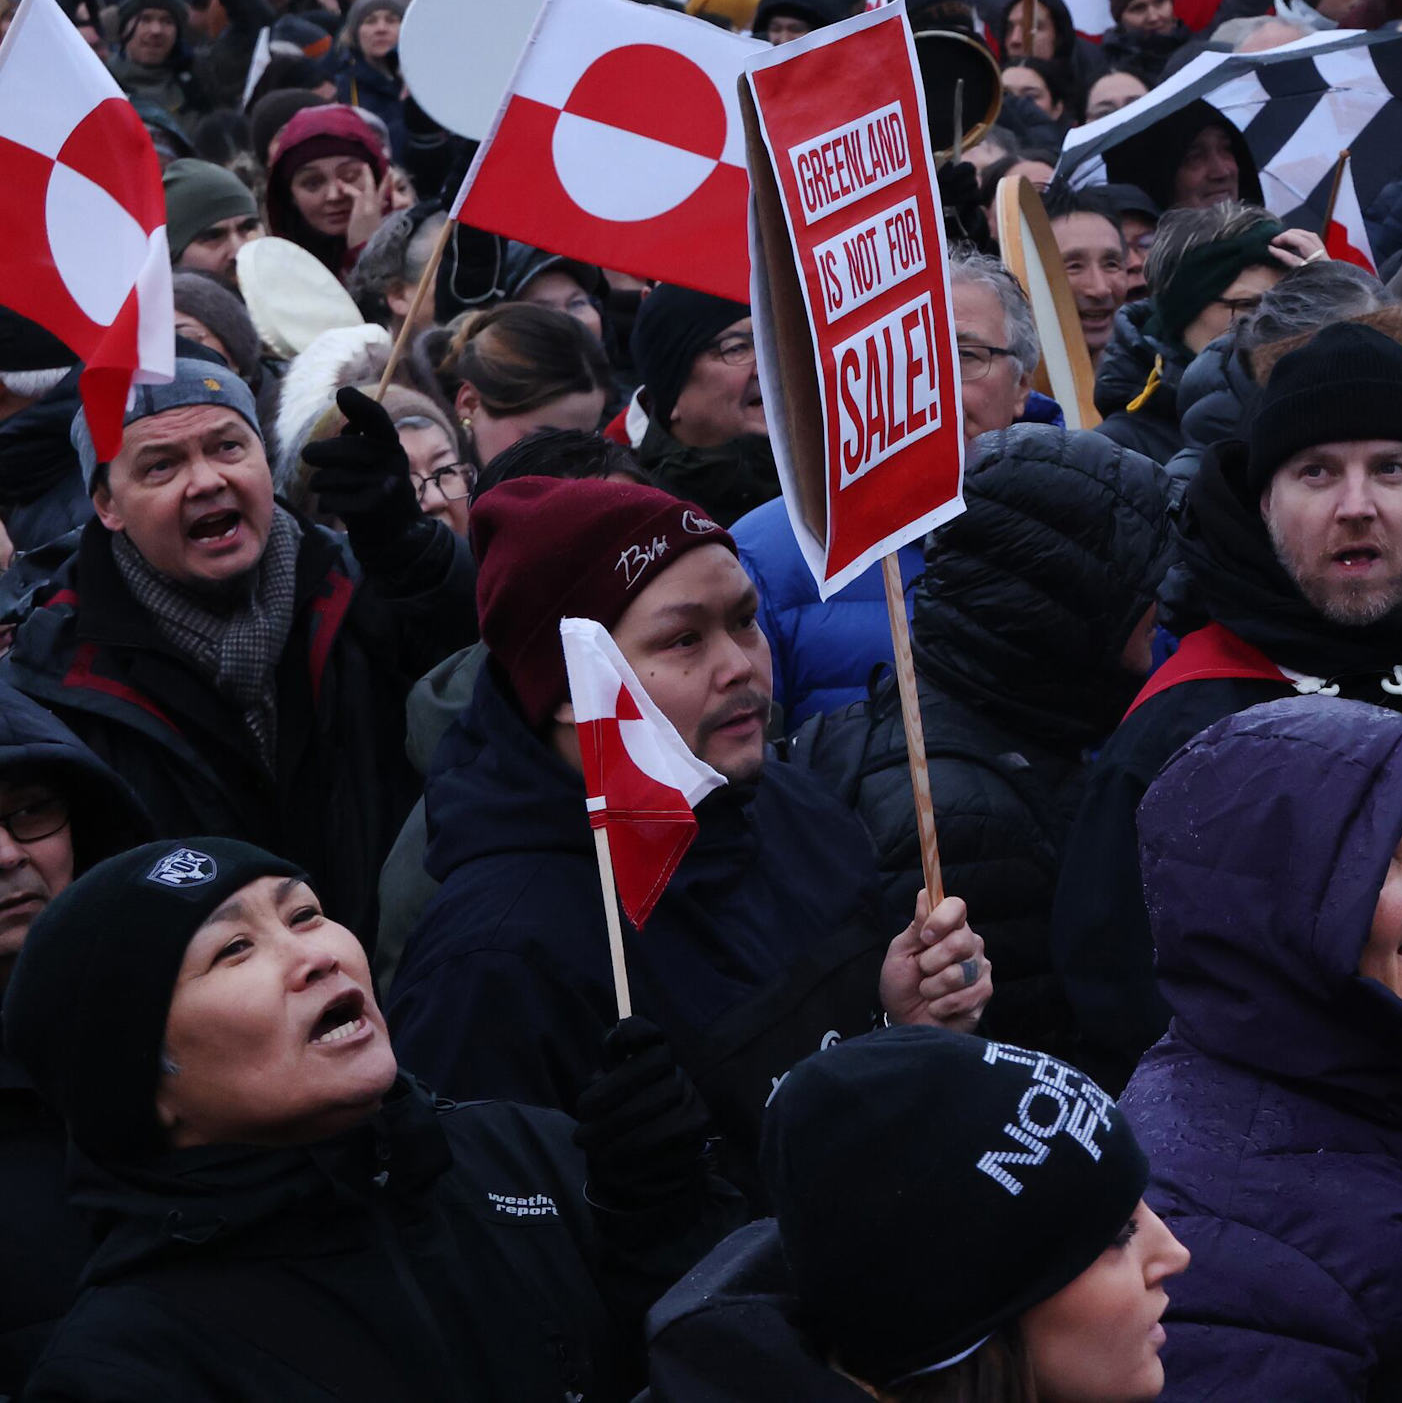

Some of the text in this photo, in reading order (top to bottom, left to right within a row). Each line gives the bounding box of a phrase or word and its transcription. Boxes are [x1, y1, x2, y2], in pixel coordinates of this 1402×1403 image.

[798, 111, 907, 213] GREENLAND
[820, 213, 922, 314] IS NOT FOR
[840, 302, 939, 476] SALE!
